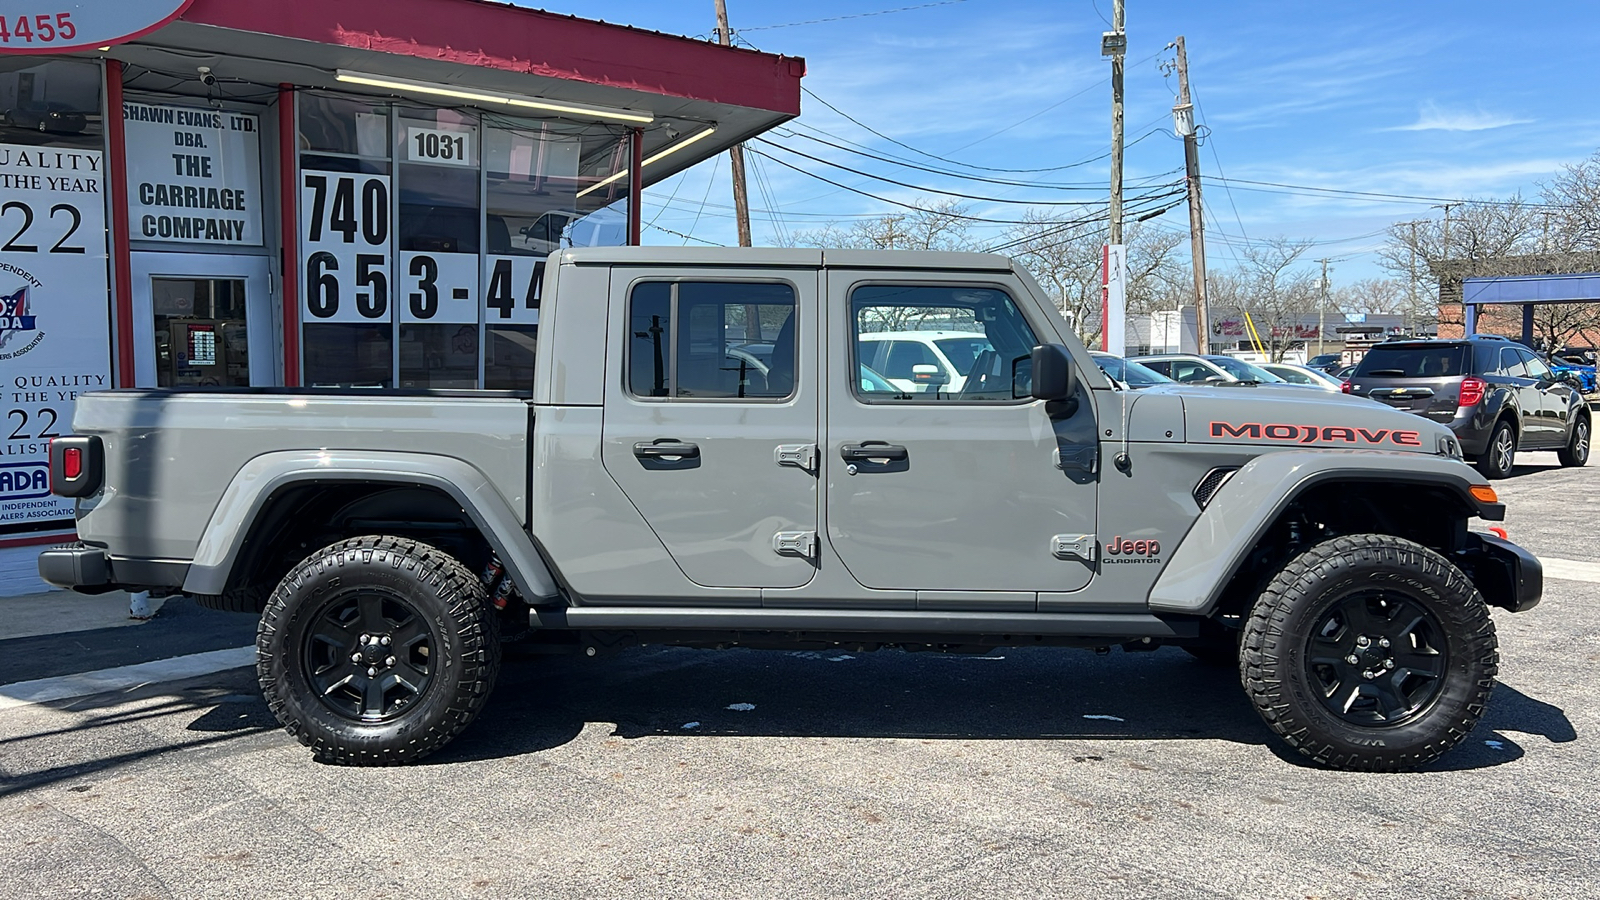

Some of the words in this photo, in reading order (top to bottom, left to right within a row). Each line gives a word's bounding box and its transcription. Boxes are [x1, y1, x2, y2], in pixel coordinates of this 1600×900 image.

[122, 104, 174, 125] SHAWN
[177, 110, 225, 130] EVANS.
[230, 116, 257, 133] LTD.
[174, 131, 208, 149] DBA.
[415, 132, 464, 160] 1031
[172, 153, 213, 179] THE
[0, 173, 42, 190] THE
[46, 176, 98, 194] YEAR
[139, 182, 246, 212] CARRIAGE
[304, 175, 388, 246] 740
[141, 214, 246, 242] COMPANY
[14, 375, 106, 390] QUALITY
[11, 392, 48, 403] THE
[57, 390, 87, 401] YE
[1210, 422, 1422, 447] MOJAVE
[2, 500, 58, 511] INDEPENDENT
[1106, 535, 1161, 558] Jeep
